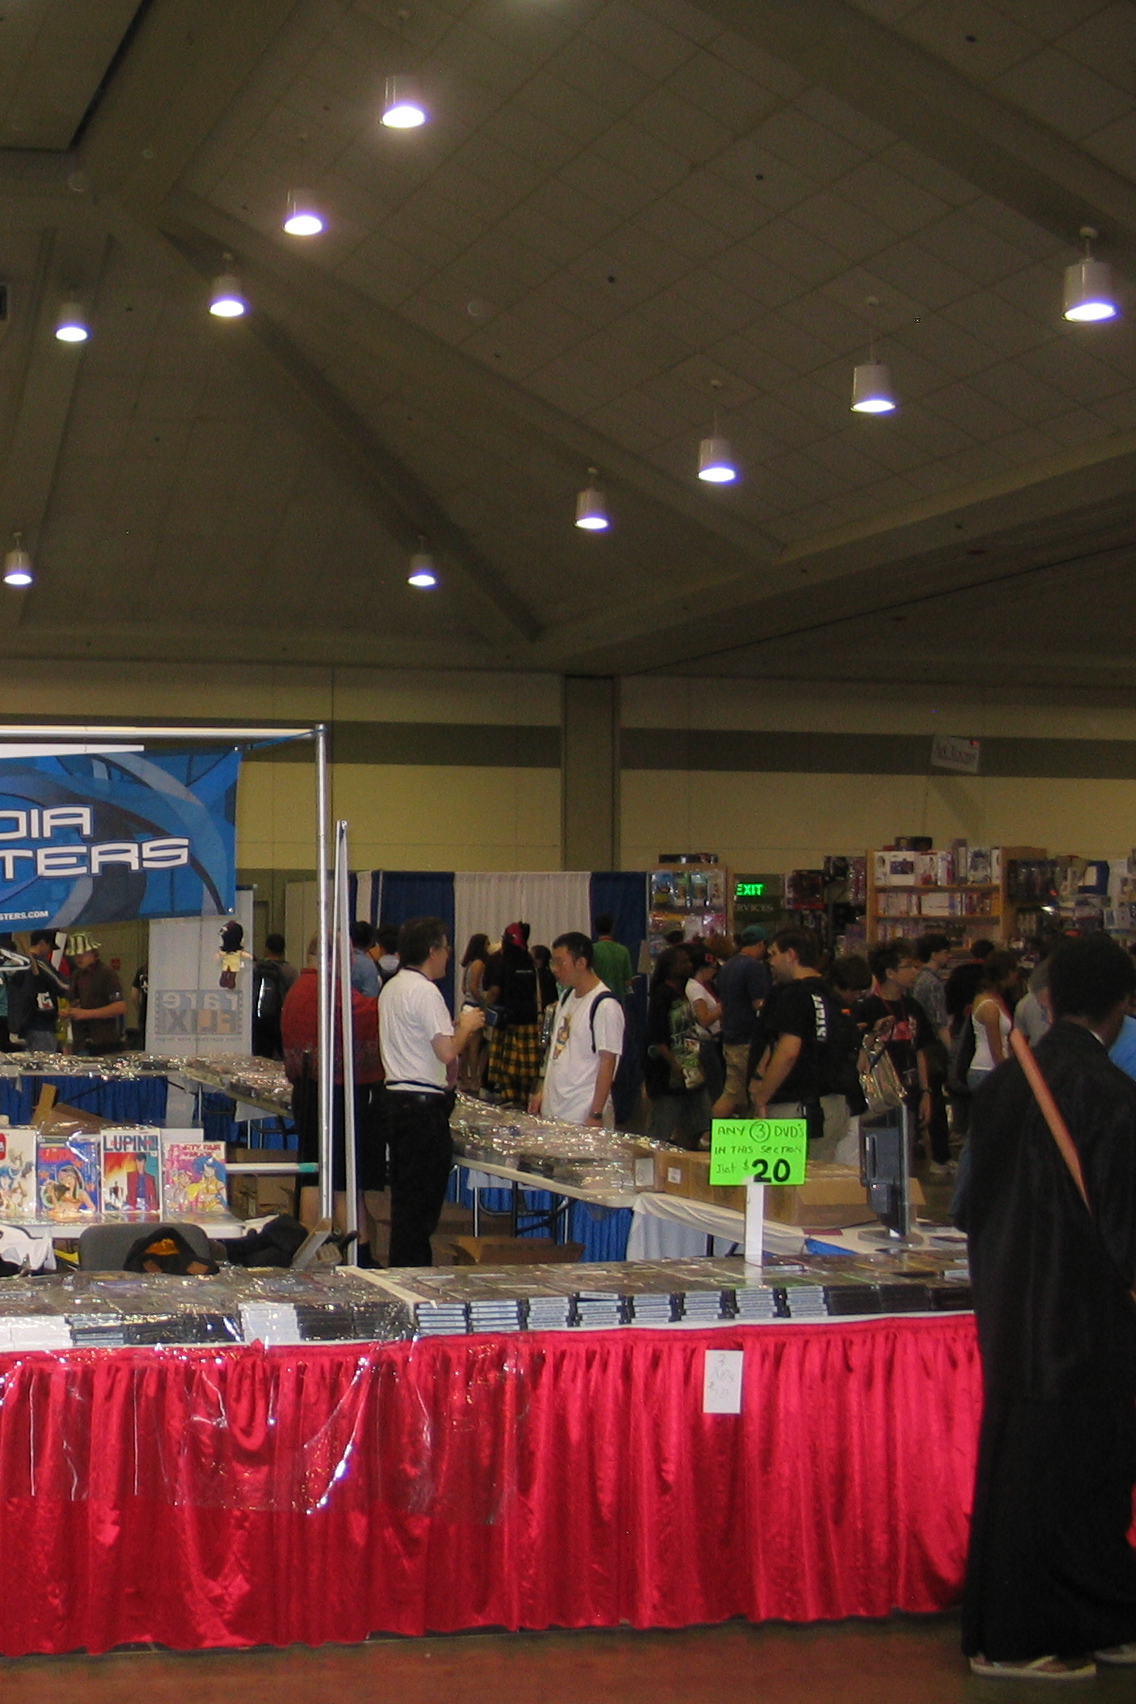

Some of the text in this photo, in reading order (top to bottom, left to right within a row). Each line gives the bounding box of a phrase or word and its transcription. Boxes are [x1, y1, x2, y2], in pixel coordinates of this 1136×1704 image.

[736, 883, 764, 896] EXIT
[717, 1126, 745, 1136] ANY
[103, 1134, 147, 1152] LUPIN
[714, 1146, 726, 1155] IN
[731, 1145, 754, 1154] THIS
